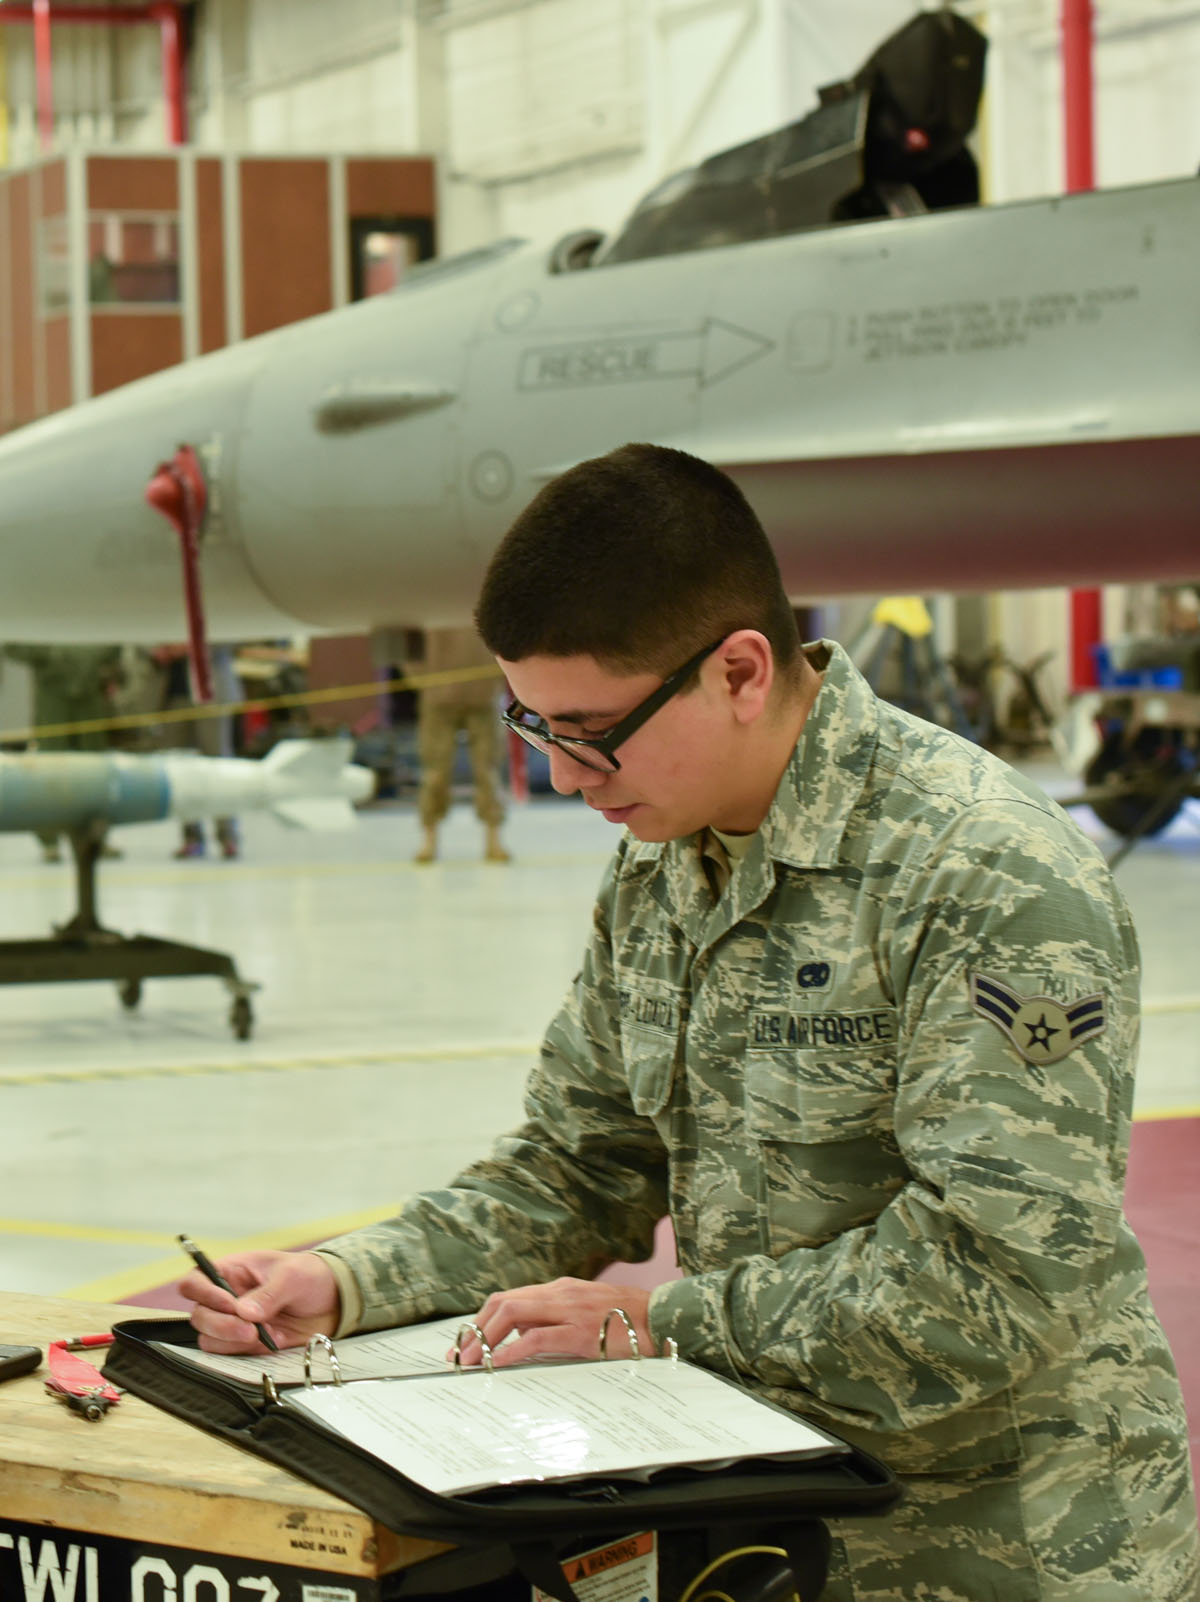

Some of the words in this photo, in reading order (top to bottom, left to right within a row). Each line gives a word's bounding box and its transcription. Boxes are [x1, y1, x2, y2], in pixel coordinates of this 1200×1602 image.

[537, 346, 657, 381] RESCUE
[812, 1012, 893, 1046] FORCE
[290, 1539, 315, 1552] MADE
[318, 1542, 327, 1552] IN
[329, 1545, 348, 1556] USA
